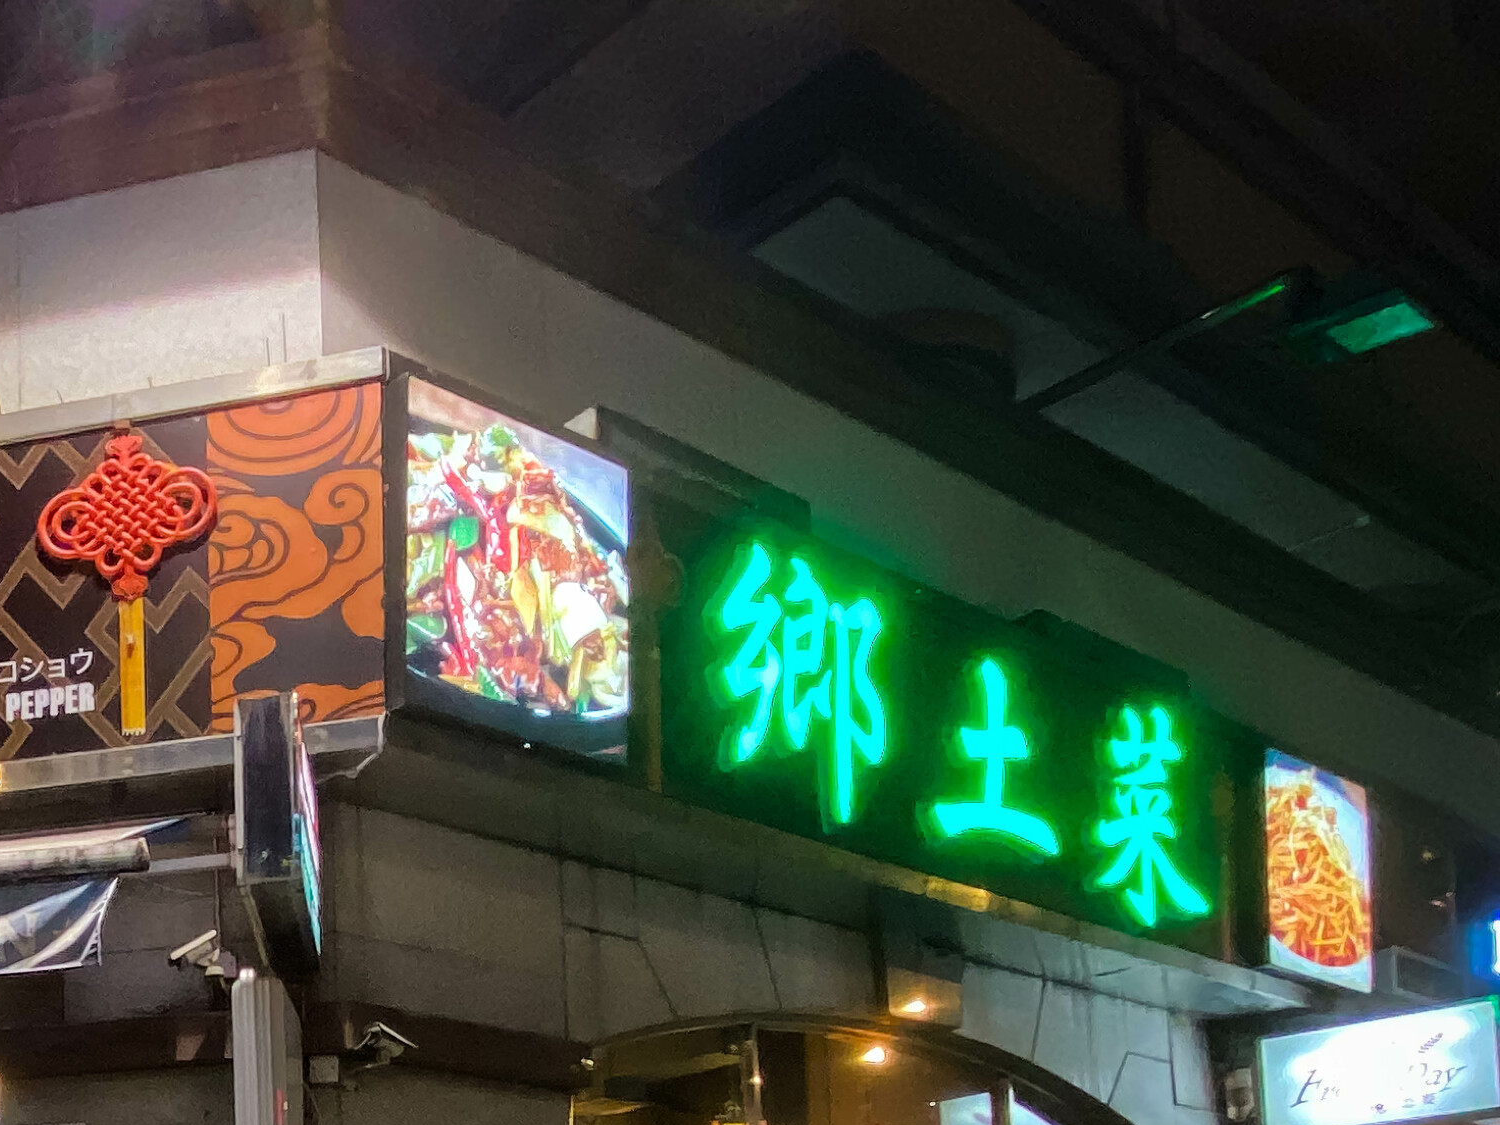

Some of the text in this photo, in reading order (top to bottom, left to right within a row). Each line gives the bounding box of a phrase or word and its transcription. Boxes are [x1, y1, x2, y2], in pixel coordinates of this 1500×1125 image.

[5, 681, 96, 723] PEPPER
[713, 540, 1212, 928] 鄉土菜
